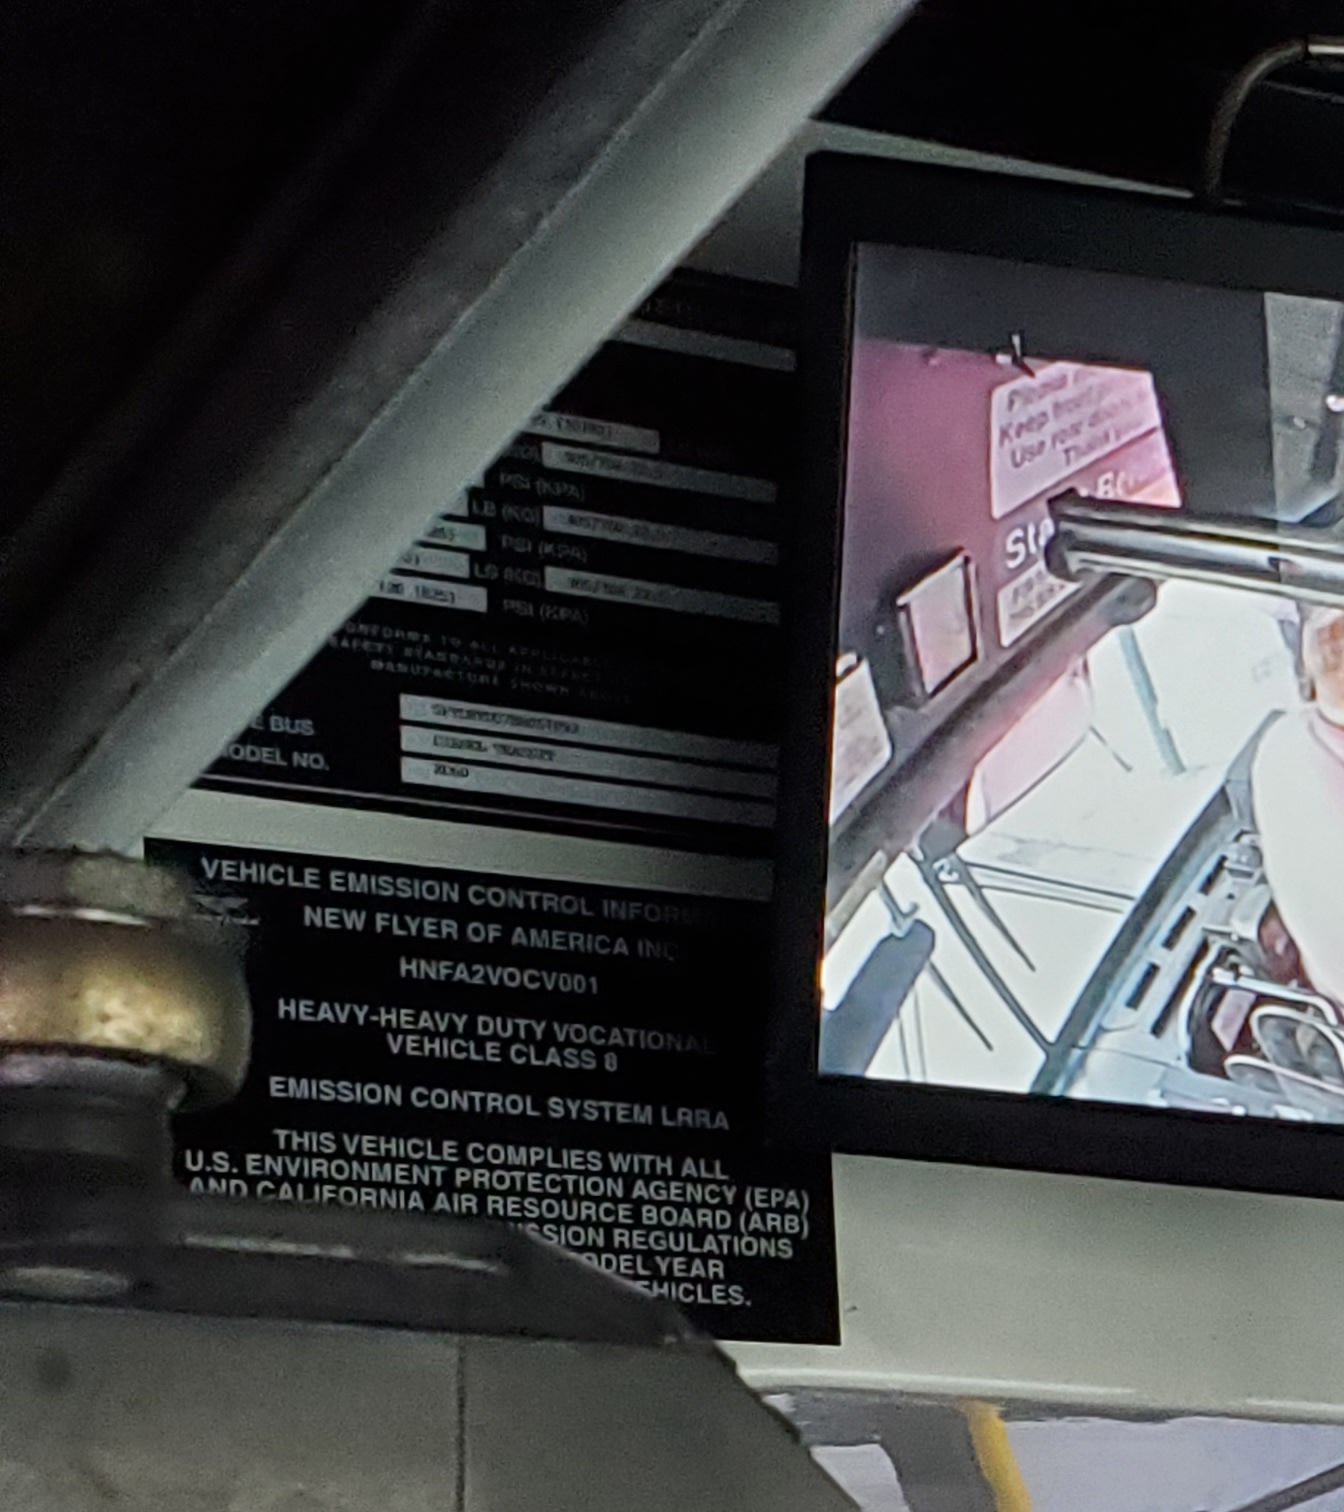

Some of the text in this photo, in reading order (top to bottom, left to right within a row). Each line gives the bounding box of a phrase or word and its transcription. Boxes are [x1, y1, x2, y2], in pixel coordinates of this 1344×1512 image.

[269, 715, 315, 736] BUS
[294, 751, 331, 771] NO.
[201, 856, 321, 890] VEHICLE
[329, 869, 460, 903] EMISSION
[467, 885, 595, 917] CONTROL
[303, 905, 366, 932] NEW
[374, 911, 459, 941] FLYER
[466, 921, 503, 944] OF
[511, 926, 630, 956] AMERICA
[278, 997, 716, 1054] HEAVY-HEAVY DUTY VOCATIONAL
[386, 1031, 618, 1072] VEHICLE CLASS 8
[269, 1075, 403, 1106] EMISSION
[410, 1087, 541, 1116] CONTROL
[548, 1096, 653, 1125] SYSTEM
[272, 1128, 730, 1180] THIS VEHICLE COMPLIES WITH ALL
[185, 1149, 809, 1216] U.S. ENVIRONMENT PROTECTION AGENCY (EPA)
[190, 1177, 809, 1240] AND CALIFORNIA AIR RESOURCE BOARD (ARB)
[582, 1252, 725, 1281] DEL YEAR
[612, 1228, 794, 1259] REGULATIONS
[634, 1280, 752, 1306] HICLES.
